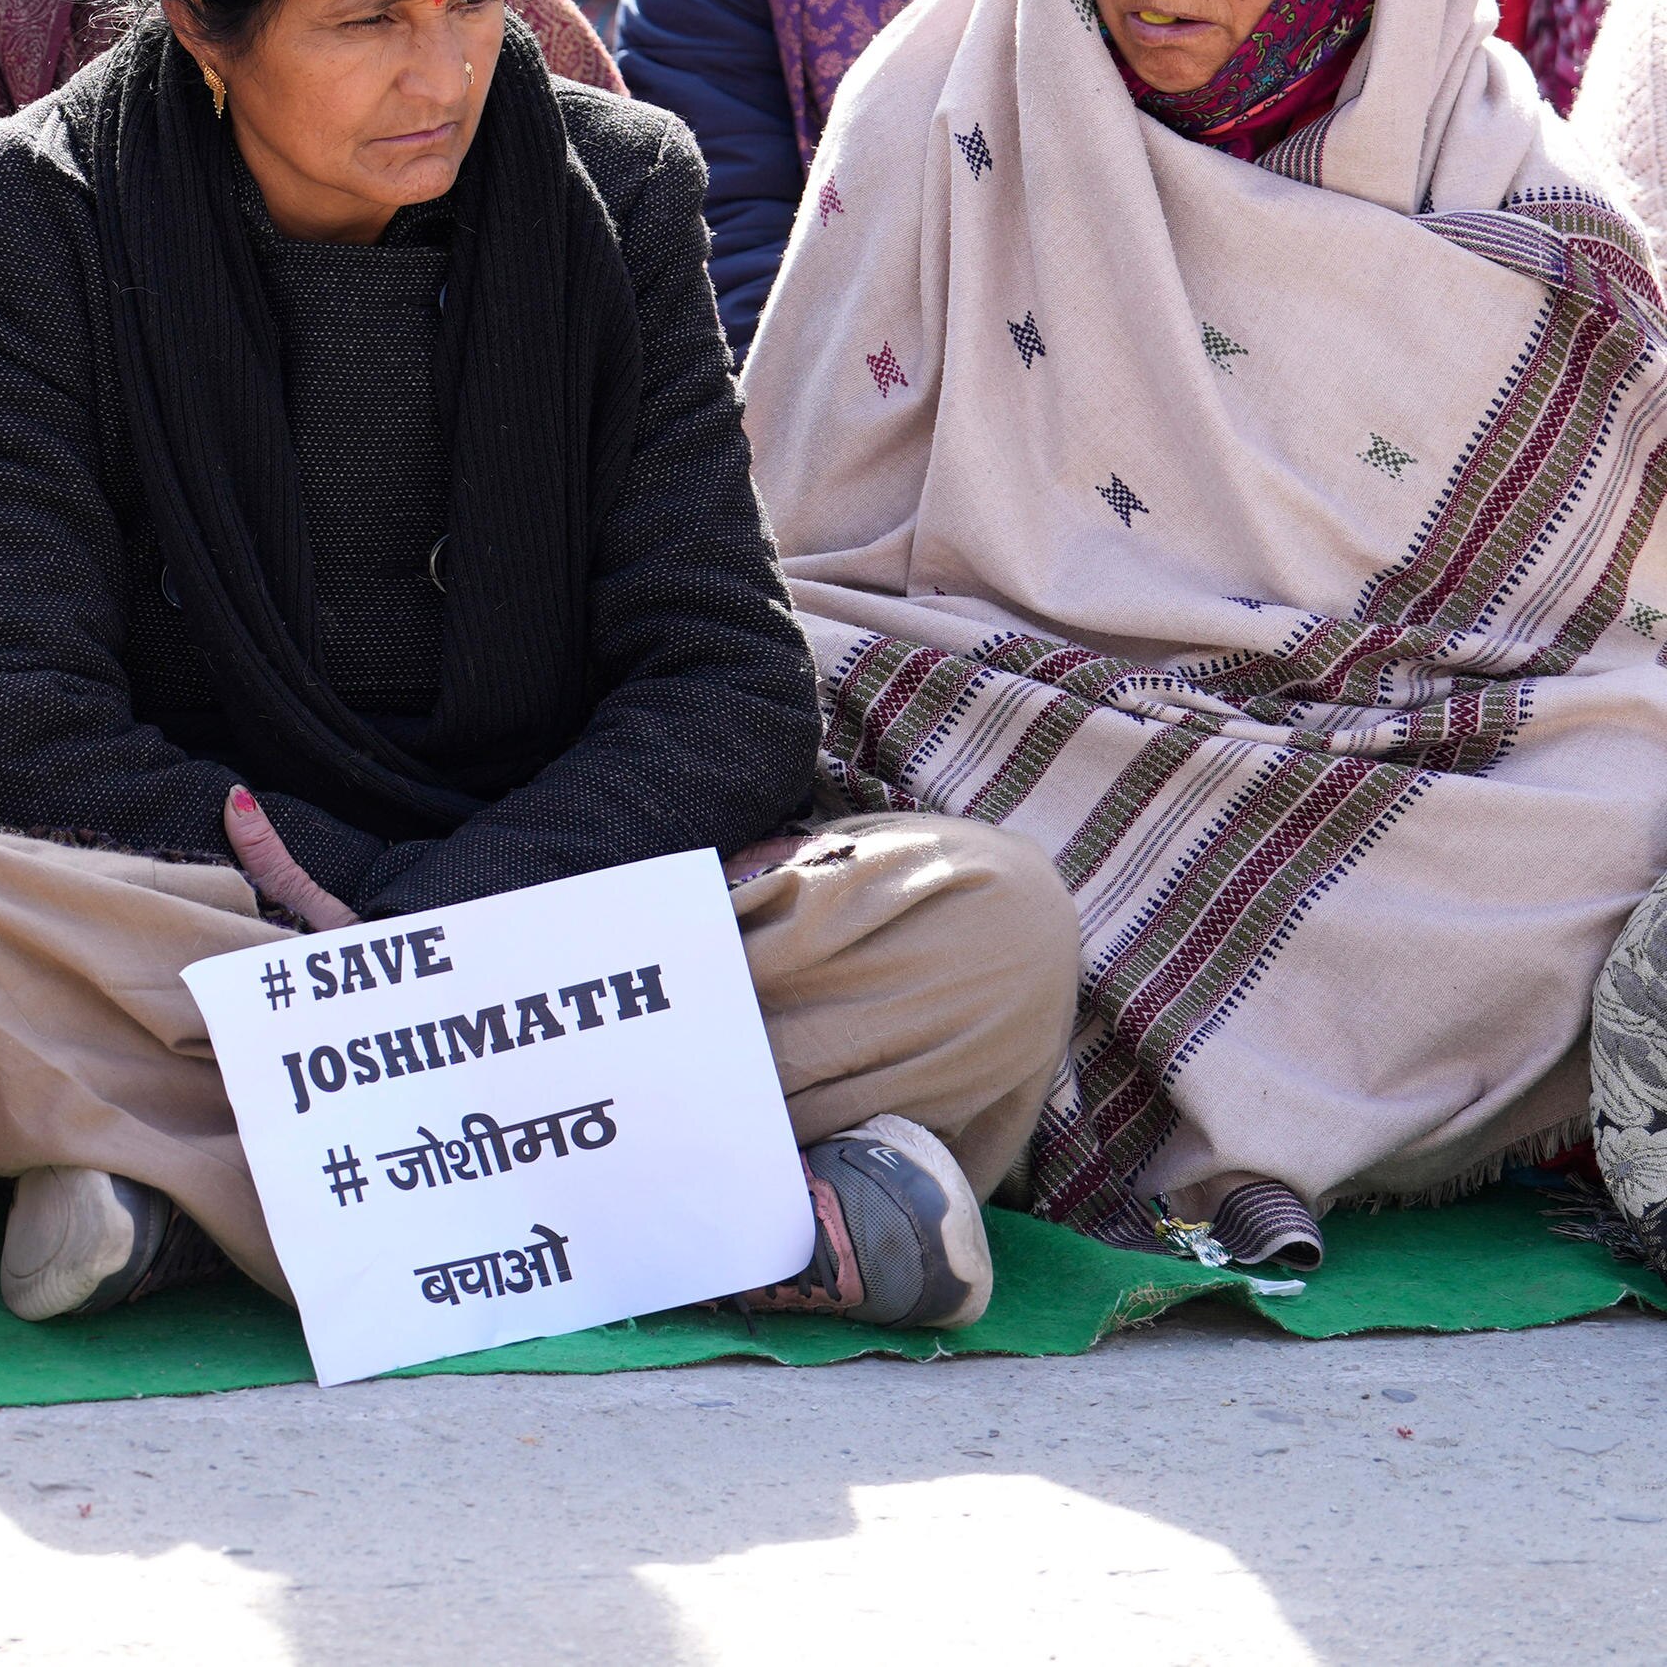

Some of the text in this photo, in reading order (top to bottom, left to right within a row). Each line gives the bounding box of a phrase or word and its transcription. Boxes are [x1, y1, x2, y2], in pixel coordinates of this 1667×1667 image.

[306, 925, 454, 1001] SAVE
[281, 963, 671, 1114] JOSHIMATH
[375, 1098, 617, 1191] जोशीमठ
[413, 1223, 573, 1306] बचाओ
